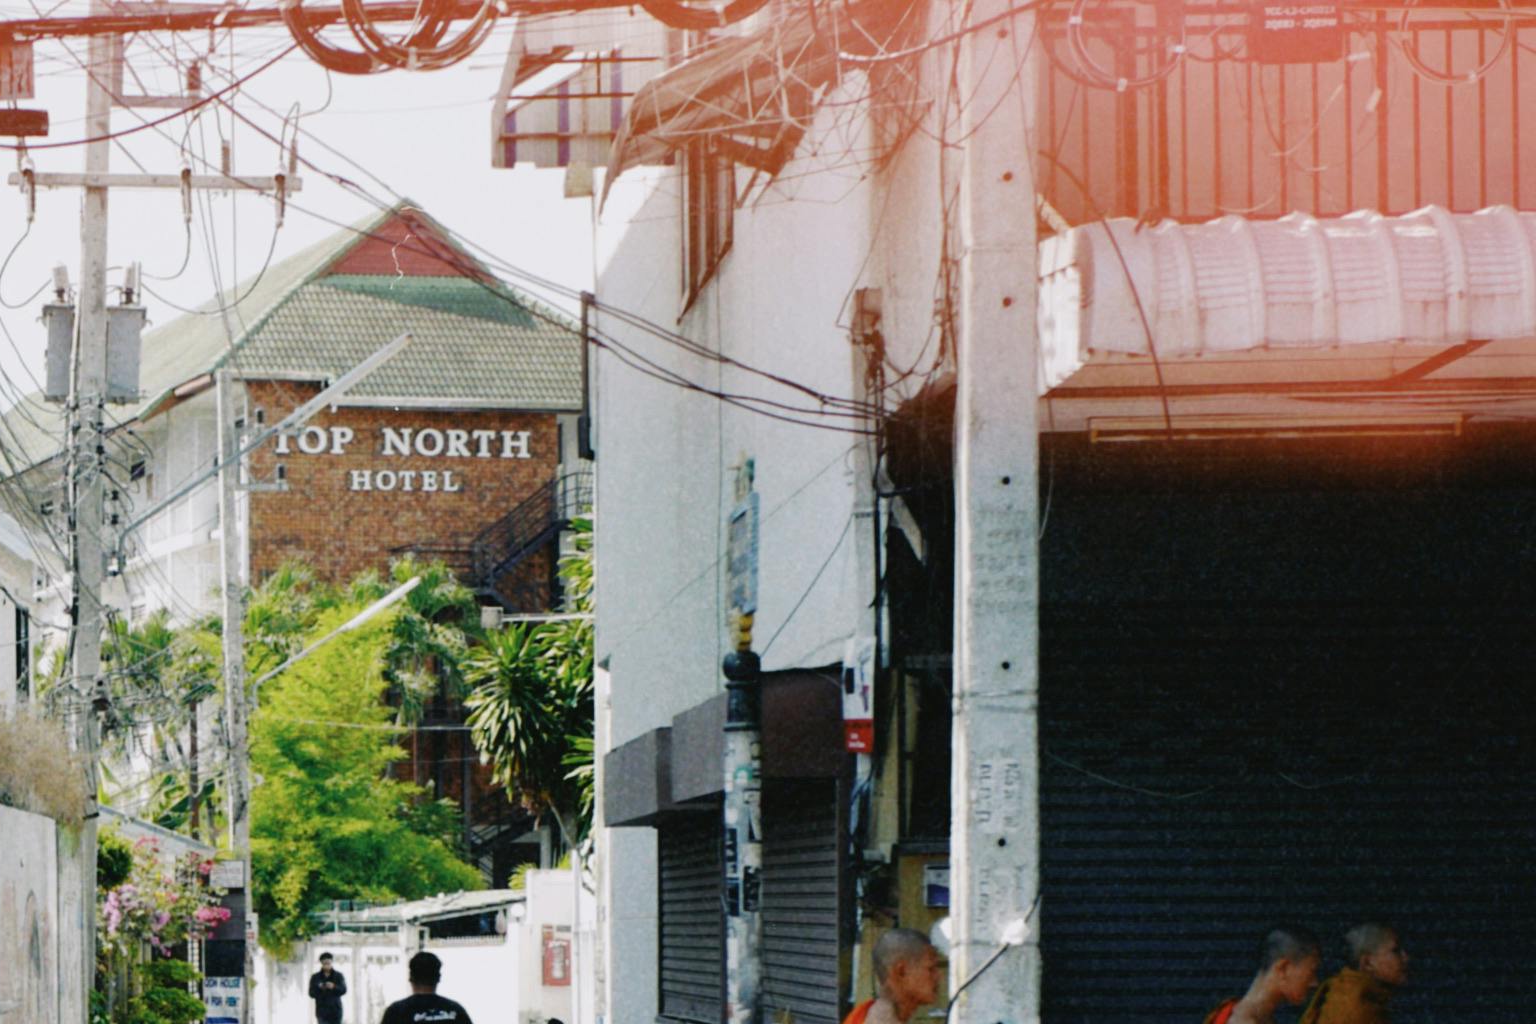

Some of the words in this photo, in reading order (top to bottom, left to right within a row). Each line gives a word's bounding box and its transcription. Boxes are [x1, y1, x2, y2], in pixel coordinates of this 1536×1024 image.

[275, 426, 354, 455] TOP
[382, 428, 532, 459] NORTH
[351, 470, 460, 492] HOTEL
